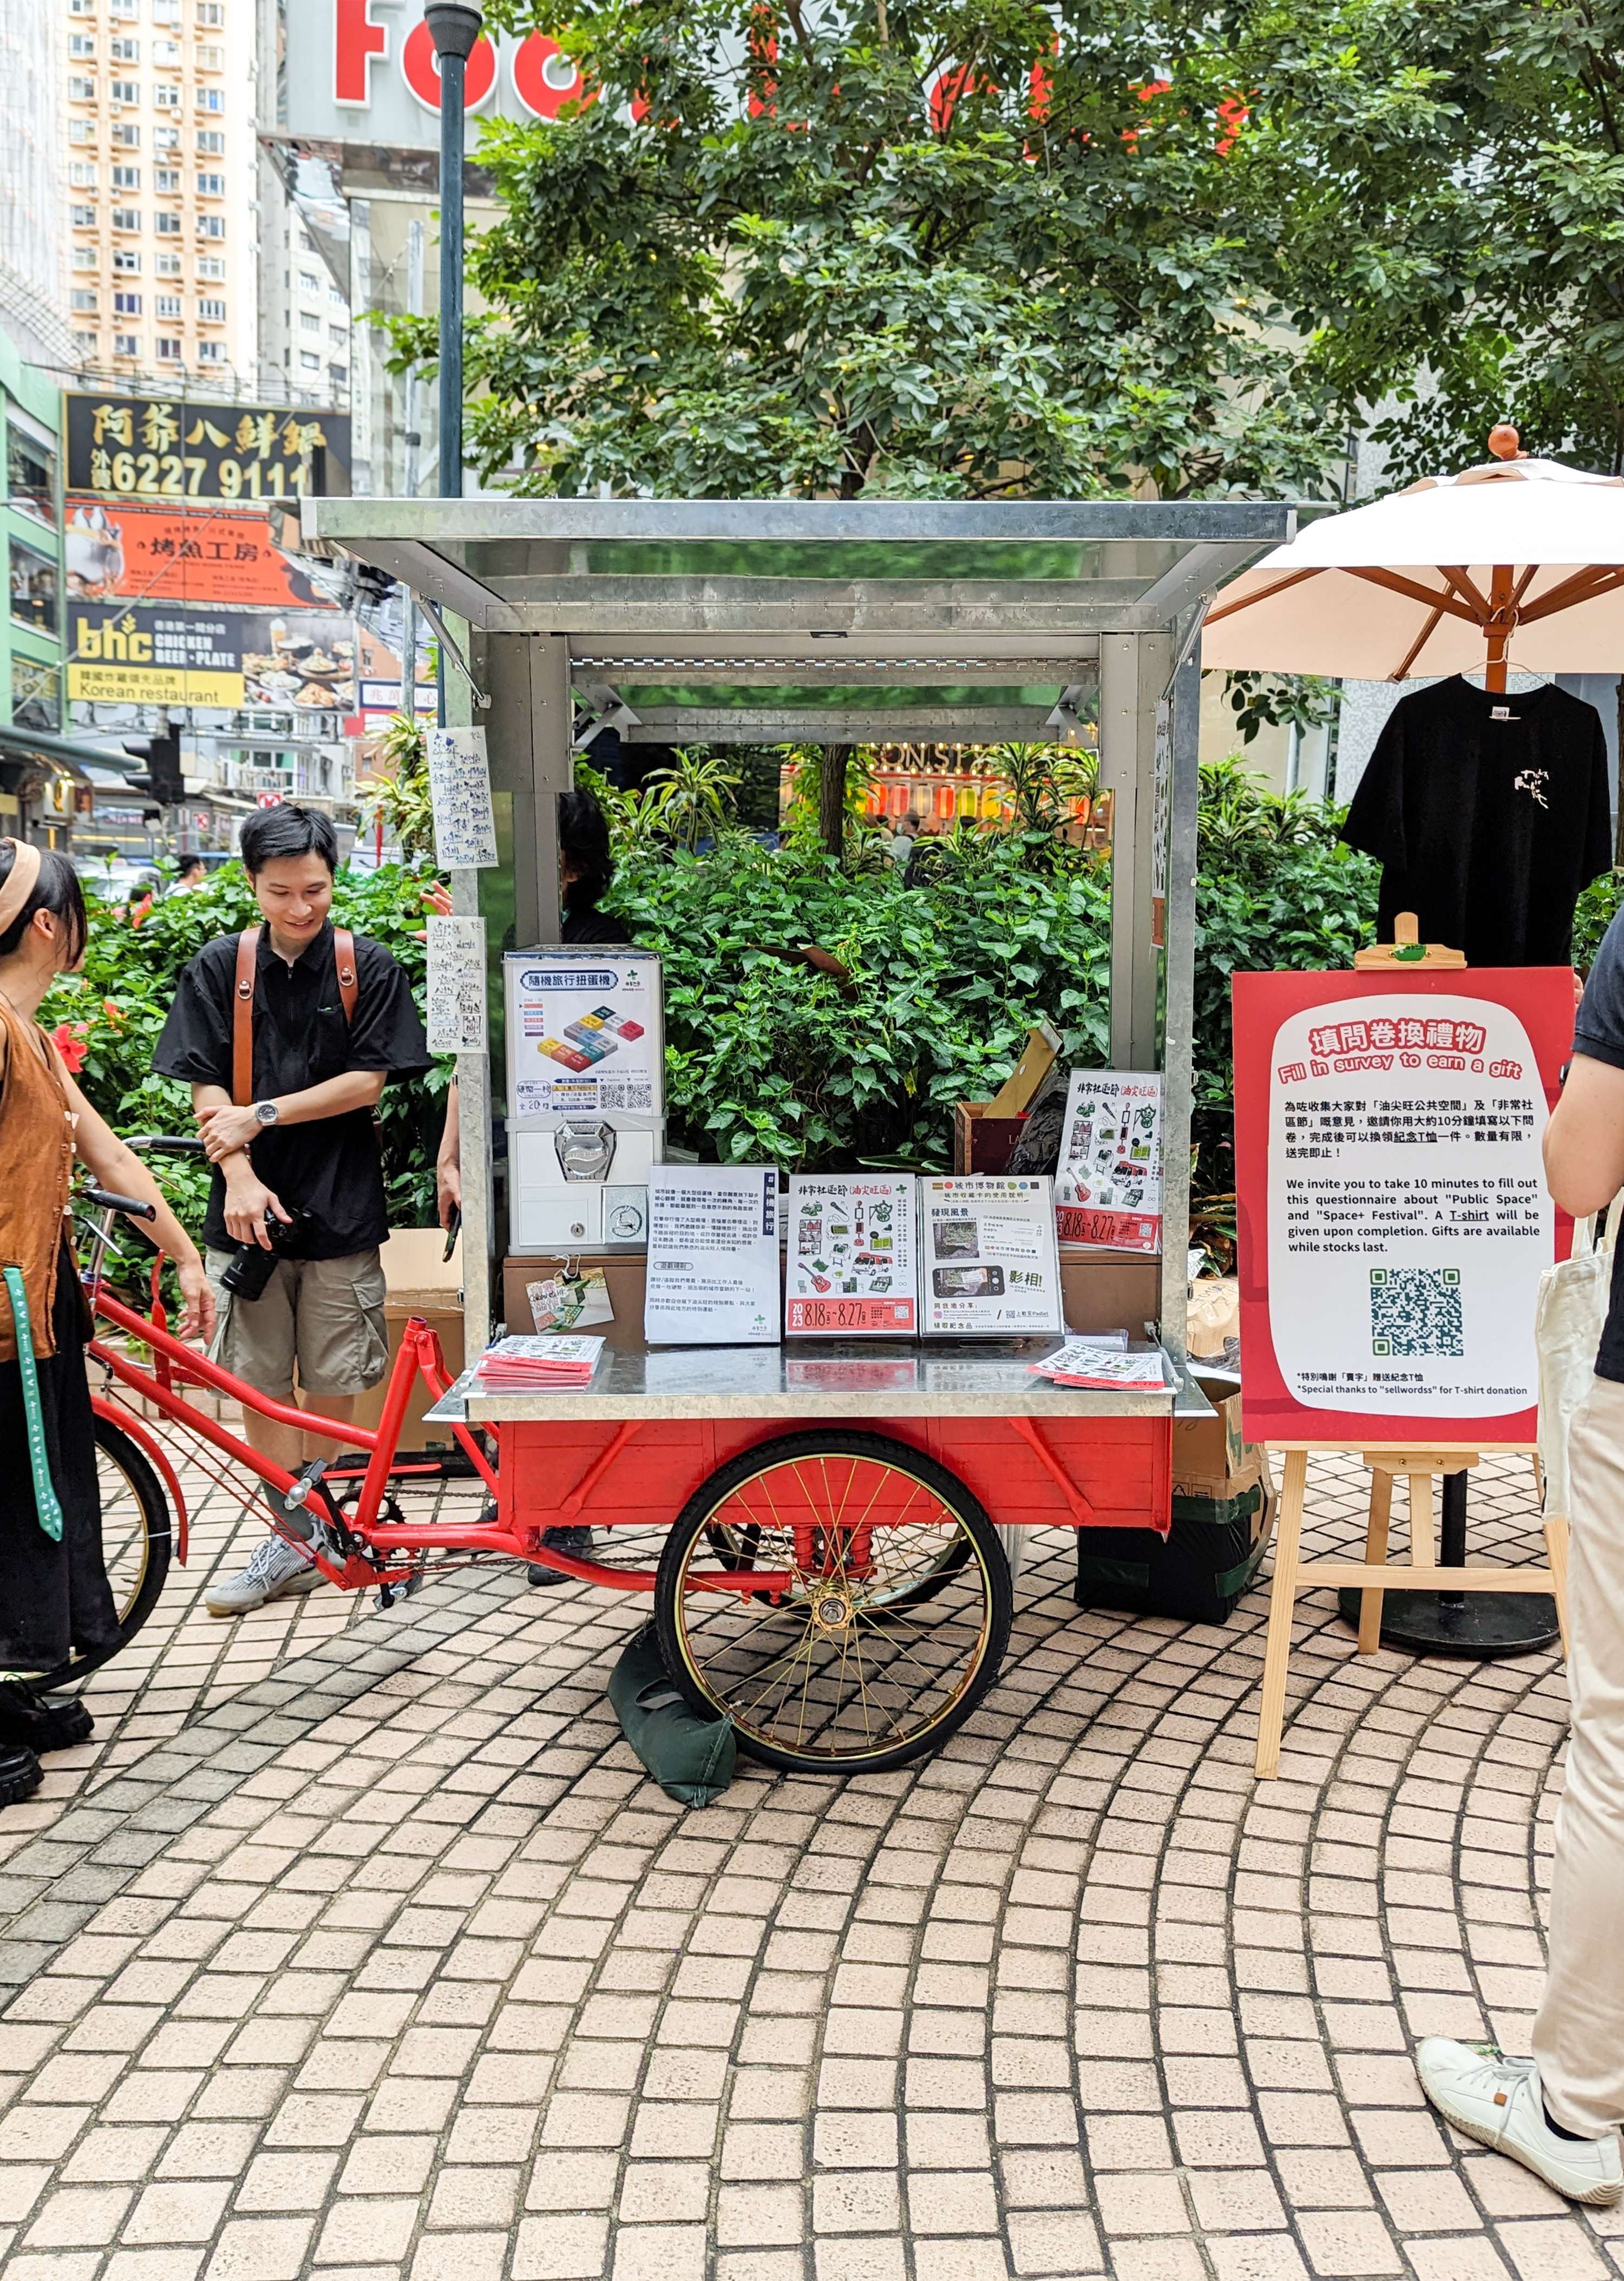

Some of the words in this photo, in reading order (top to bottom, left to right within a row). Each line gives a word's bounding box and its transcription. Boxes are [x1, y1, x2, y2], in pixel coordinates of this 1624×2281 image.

[112, 451, 207, 496] 6227
[219, 458, 308, 499] 9111
[150, 537, 259, 562] 烤魚工房
[77, 617, 153, 662] bhc
[154, 633, 212, 651] CHICKEN
[80, 682, 135, 699] Korean
[140, 687, 219, 703] restaurant
[370, 688, 437, 705] 兆萬心
[528, 974, 610, 986] 隨機旅行扭蛋機
[1310, 1020, 1485, 1055] 填問卷換禮物
[1280, 1064, 1306, 1082] Fill
[1312, 1061, 1328, 1076] in
[1336, 1054, 1393, 1071] survey
[1401, 1053, 1419, 1067] to
[1428, 1055, 1465, 1069] earn
[1472, 1058, 1483, 1071] a
[1490, 1061, 1522, 1078] gift
[1077, 1081, 1119, 1097] 非常社區節
[1286, 1147, 1340, 1158] 送完即止！
[798, 1184, 848, 1197] 非常社區節
[849, 1185, 893, 1195] (油尖旺區)
[954, 1181, 1005, 1190] 城市博物館
[1286, 1179, 1304, 1189] We
[1307, 1178, 1340, 1189] invite
[1344, 1181, 1365, 1191] you
[1368, 1179, 1381, 1189] to
[1384, 1178, 1410, 1189] take
[1414, 1179, 1427, 1189] 10
[1431, 1178, 1479, 1189] minutes
[1482, 1179, 1495, 1188] to
[1498, 1178, 1514, 1188] fill
[1517, 1179, 1538, 1188] out
[1286, 1194, 1309, 1204] this
[1315, 1194, 1397, 1207] questionnaire
[1404, 1194, 1438, 1204] about
[1445, 1194, 1489, 1204] "Public
[1496, 1194, 1537, 1207] Space"
[931, 1208, 969, 1217] 發現風景
[1287, 1210, 1309, 1220] and
[1317, 1210, 1365, 1222] "Space+
[1372, 1210, 1428, 1220] Festival".
[1435, 1210, 1443, 1220] A
[1449, 1209, 1489, 1222] T-shirt
[1496, 1209, 1518, 1220] will
[1524, 1209, 1539, 1220] be
[1064, 1212, 1082, 1237] 8.18
[1091, 1215, 1114, 1240] 8.27
[1288, 1225, 1319, 1238] given
[1324, 1228, 1353, 1238] upon
[1357, 1225, 1427, 1238] completion.
[1432, 1225, 1459, 1236] Gifts
[1487, 1225, 1540, 1236] available
[1288, 1241, 1320, 1252] while
[1323, 1242, 1360, 1252] stocks
[1363, 1242, 1388, 1252] last.
[793, 1303, 803, 1314] 20
[805, 1303, 826, 1326] 8.18
[838, 1303, 862, 1326] 8.27
[792, 1315, 803, 1326] 23
[1335, 1385, 1366, 1393] thanks
[1379, 1386, 1437, 1394] "sellwordss"
[1439, 1386, 1453, 1394] for
[1455, 1386, 1484, 1394] T-shirt
[1487, 1386, 1527, 1394] donation
